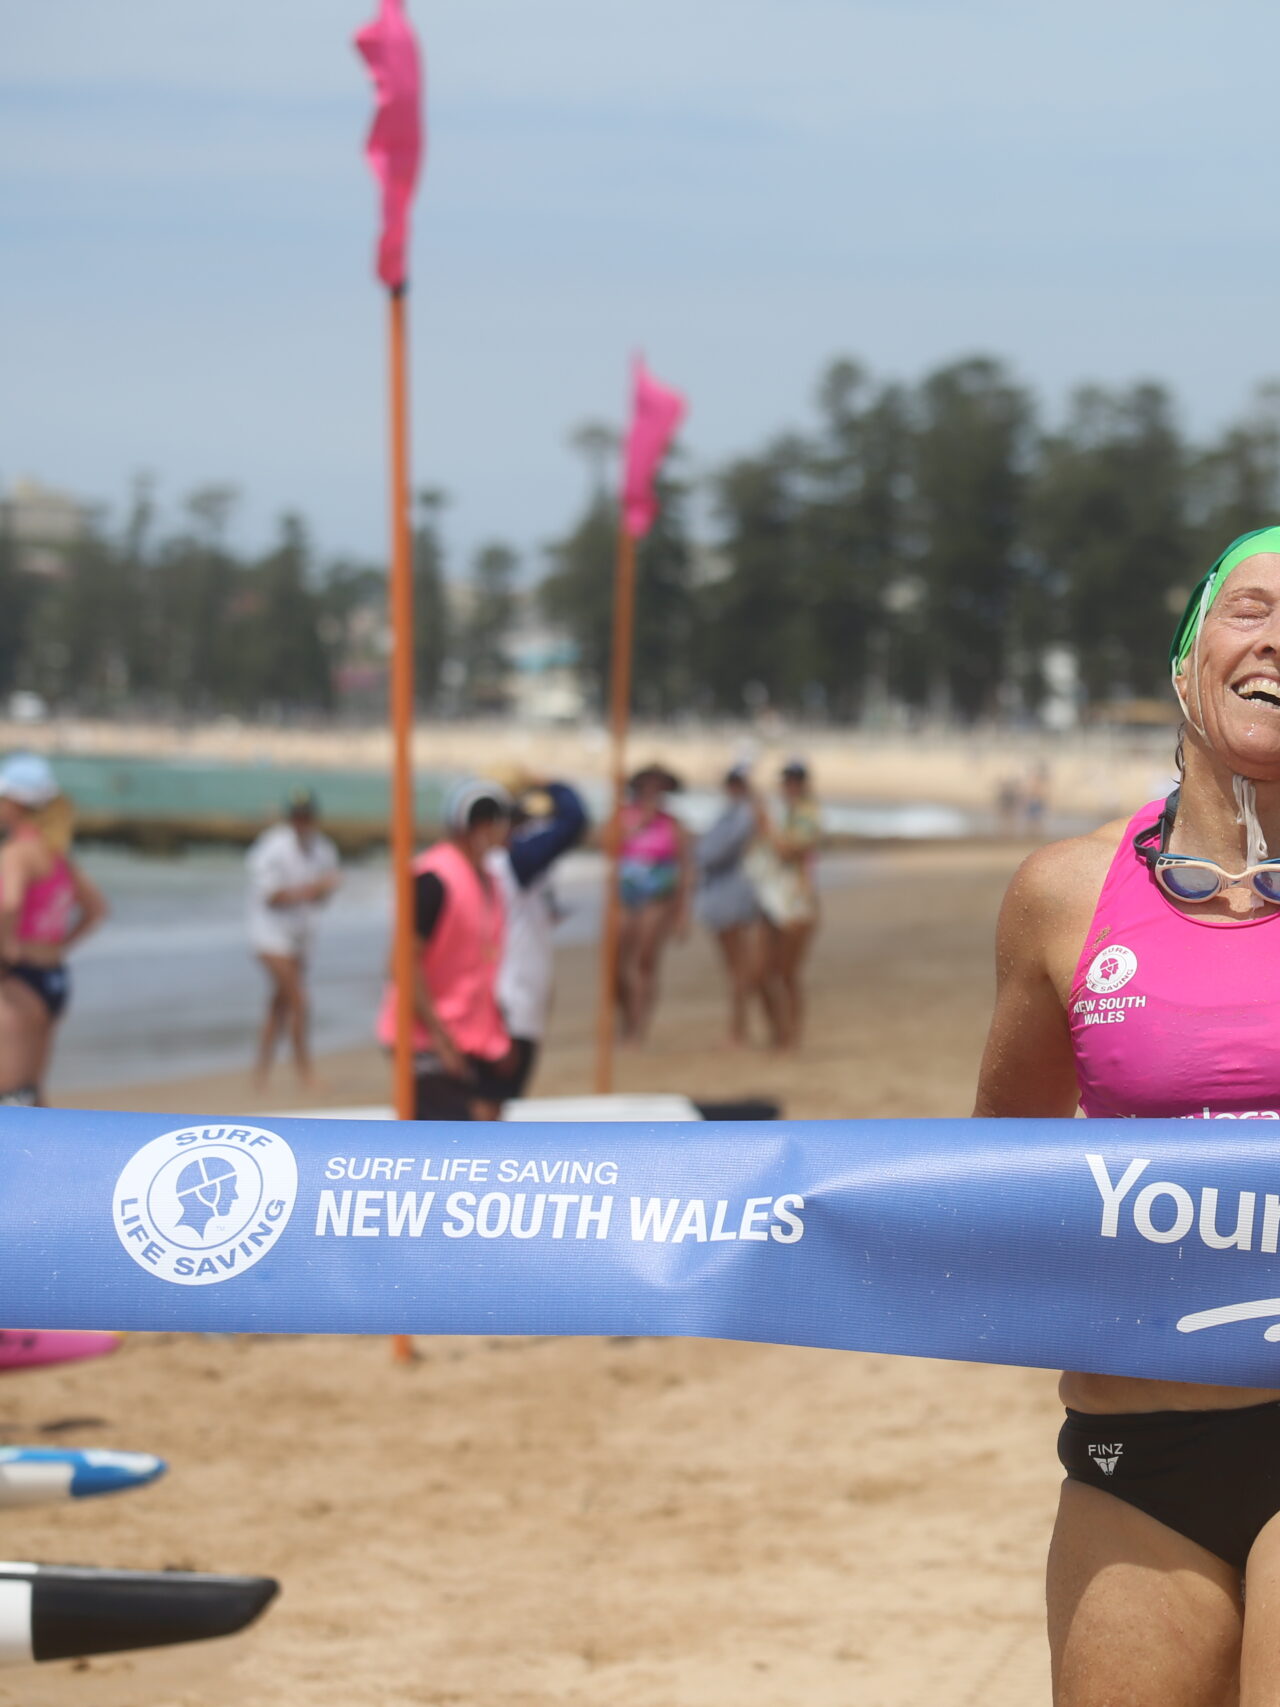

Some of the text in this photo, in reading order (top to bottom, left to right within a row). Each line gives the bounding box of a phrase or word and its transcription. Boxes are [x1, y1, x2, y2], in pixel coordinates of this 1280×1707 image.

[1100, 968, 1134, 992] SAVING
[1073, 996, 1146, 1014] NEW SOUTH
[1084, 1011, 1125, 1025] WALES
[175, 1128, 273, 1147] SURF
[324, 1157, 619, 1185] SURF LIFE SAVING
[315, 1189, 805, 1244] NEW SOUTH WALES
[121, 1197, 286, 1277] LIFE SAVING
[1088, 1443, 1123, 1456] FINZ
